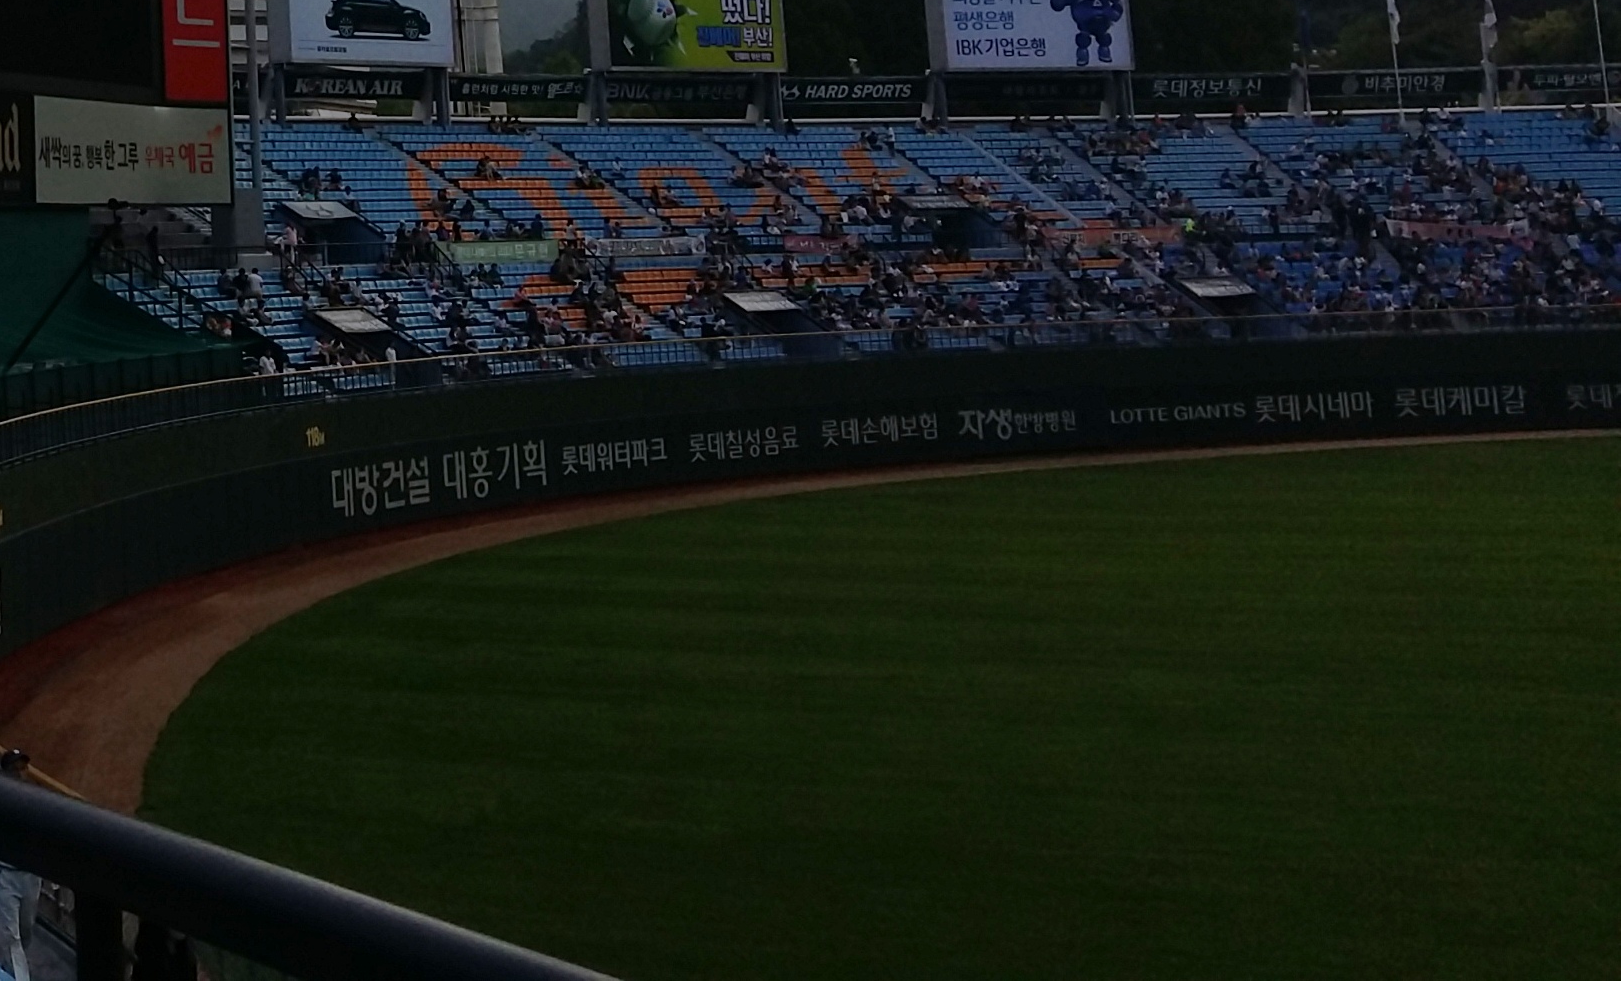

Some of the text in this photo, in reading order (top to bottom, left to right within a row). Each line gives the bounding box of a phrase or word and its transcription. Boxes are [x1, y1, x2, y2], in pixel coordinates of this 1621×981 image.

[953, 10, 1015, 31] 평생은행
[743, 26, 773, 48] 부산!
[294, 77, 404, 95] KOREAN AIR
[804, 83, 913, 98] HARD SPORTS
[1153, 77, 1262, 99] 롯데정보통신
[179, 142, 214, 174] 예금
[330, 456, 431, 518] 대방건설
[442, 439, 548, 500] 대홍기획
[561, 437, 668, 476] 롯데워터파크
[688, 425, 800, 463] 롯데칠성음료
[821, 412, 939, 448] 롯데손해보험
[1109, 406, 1169, 425] LOTTE
[1173, 402, 1247, 421] GIANTS
[1254, 390, 1375, 423] 롯데시네마
[1394, 384, 1527, 417] 롯데케미칼
